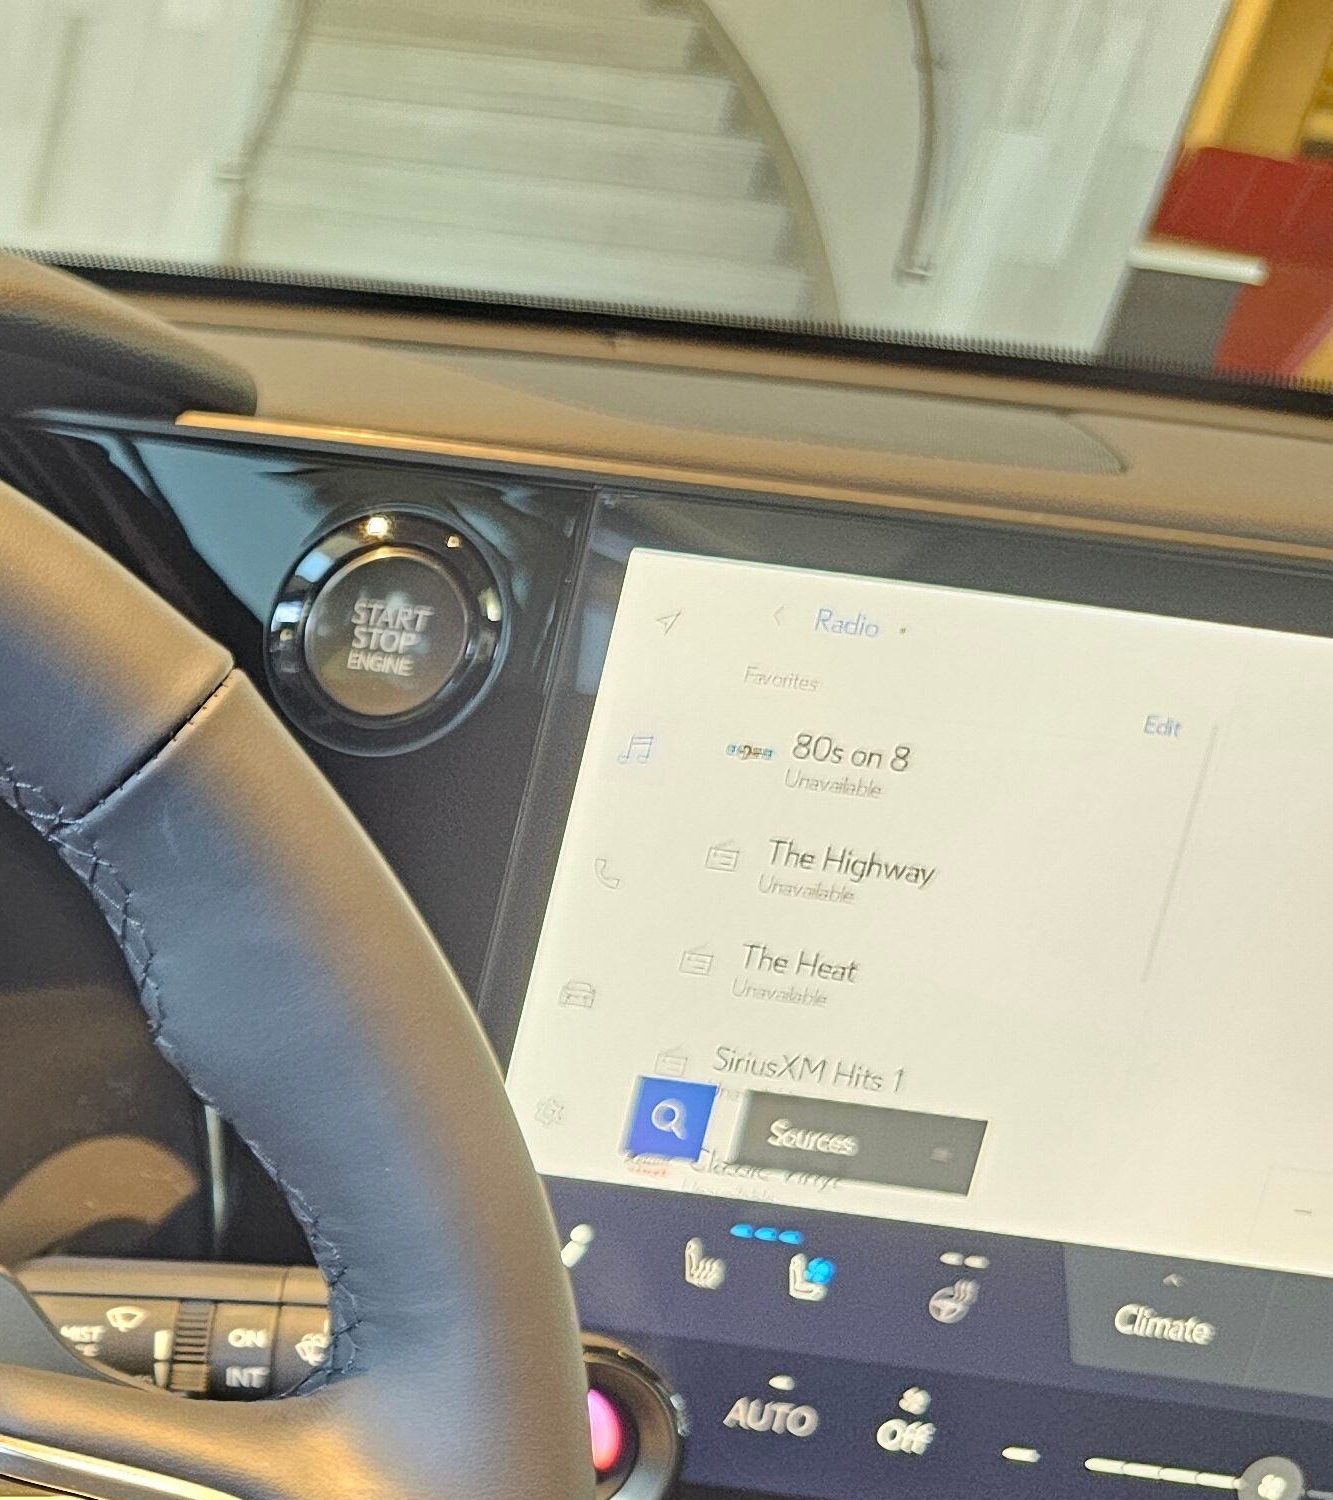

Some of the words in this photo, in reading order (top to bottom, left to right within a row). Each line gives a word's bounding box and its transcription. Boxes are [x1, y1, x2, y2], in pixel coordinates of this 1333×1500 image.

[351, 600, 433, 632] START
[814, 608, 880, 638] Radio
[351, 627, 421, 654] STOP
[346, 652, 414, 677] ENGINE
[744, 665, 820, 692] Favorites
[792, 732, 844, 766] 80s
[851, 749, 883, 770] on
[890, 744, 911, 773] 8
[785, 768, 883, 799] Unavailable
[769, 838, 815, 871] The
[822, 845, 937, 890] Highway
[758, 873, 855, 905] Unavailable
[742, 943, 789, 975] The
[796, 948, 861, 984] Heat
[711, 1046, 828, 1084] SiriusXM
[834, 1060, 883, 1092] Hits
[893, 1067, 906, 1093] 1
[767, 1117, 860, 1157] Sources
[228, 1328, 270, 1348] ON
[1114, 1303, 1217, 1346] Climate
[225, 1366, 271, 1389] INT
[723, 1396, 820, 1438] AUTO
[876, 1418, 937, 1456] Off
